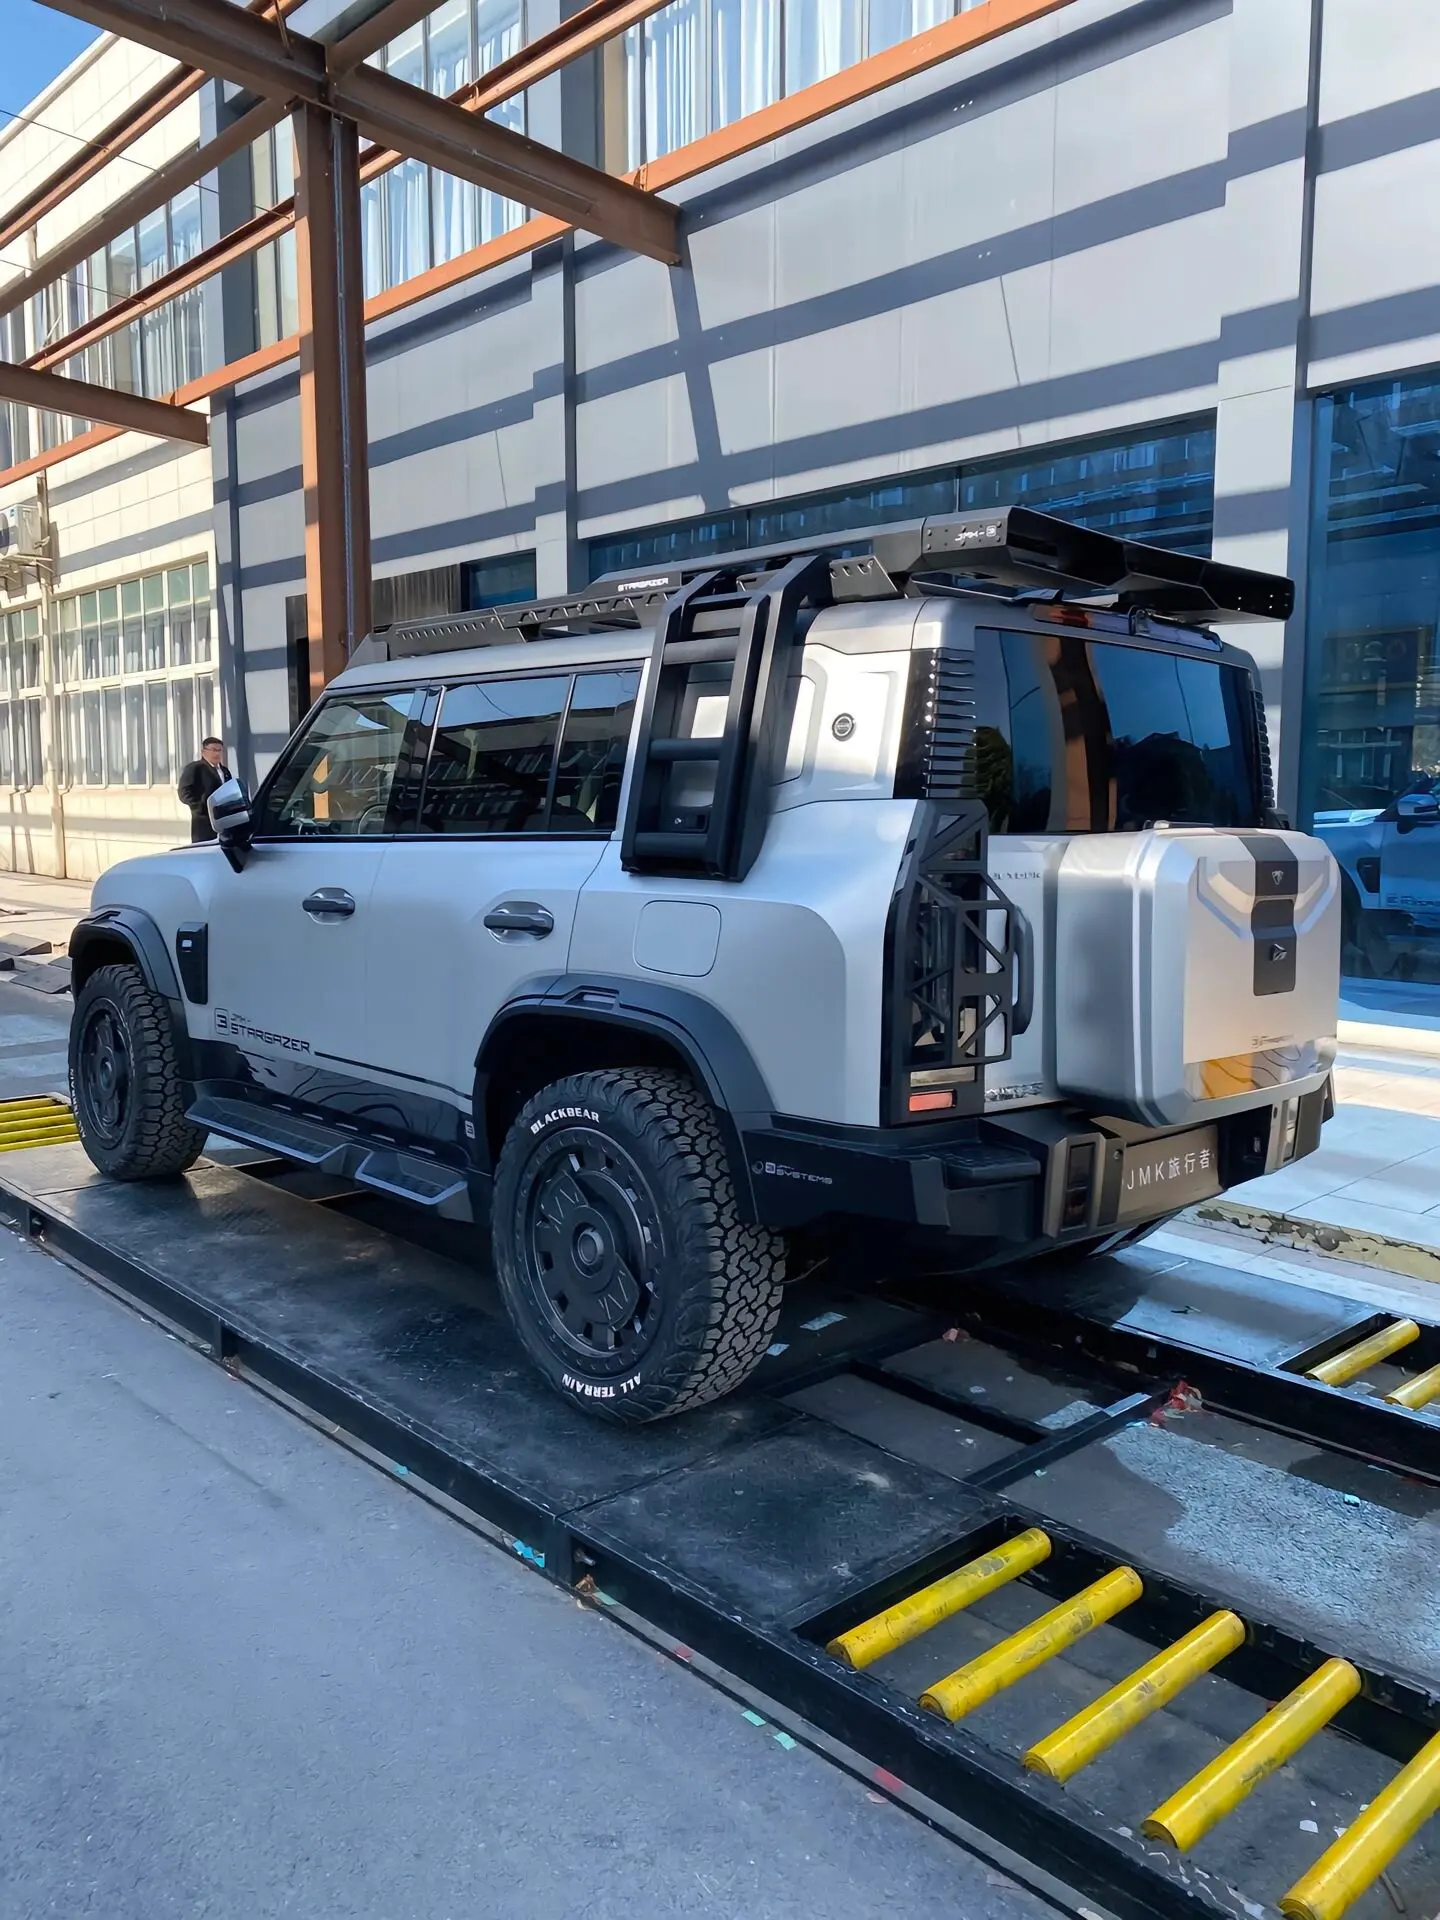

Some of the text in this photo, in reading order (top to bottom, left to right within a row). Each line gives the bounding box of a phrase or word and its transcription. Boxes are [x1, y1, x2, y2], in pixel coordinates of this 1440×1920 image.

[231, 1022, 311, 1055] STARGAZER
[530, 1107, 600, 1134] BLACKBEAR
[562, 1372, 641, 1398] ALL TERRAIN
